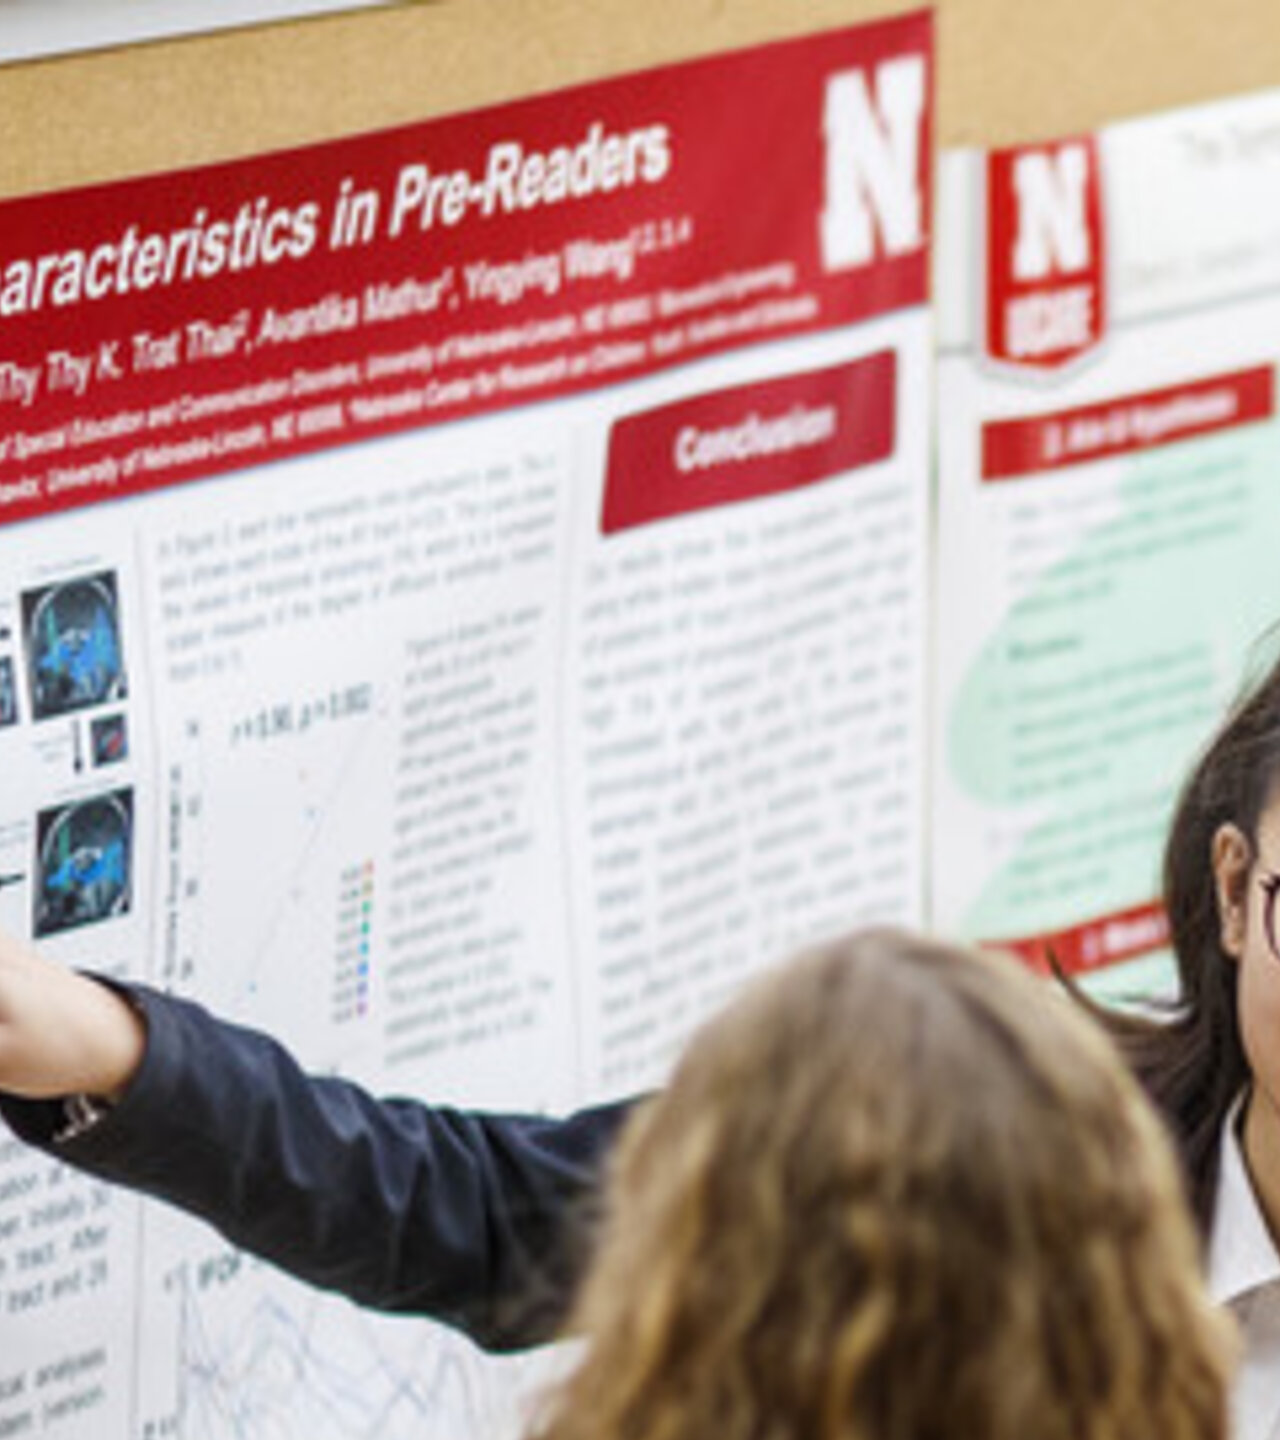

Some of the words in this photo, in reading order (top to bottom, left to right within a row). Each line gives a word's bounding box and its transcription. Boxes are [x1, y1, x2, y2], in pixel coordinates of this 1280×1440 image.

[329, 176, 380, 250] in
[388, 121, 671, 238] Pre-Readers
[820, 53, 926, 273] N
[1012, 146, 1089, 279] N
[47, 350, 92, 398] Thy
[463, 252, 561, 305] Yingying
[673, 403, 838, 474] Conclusion
